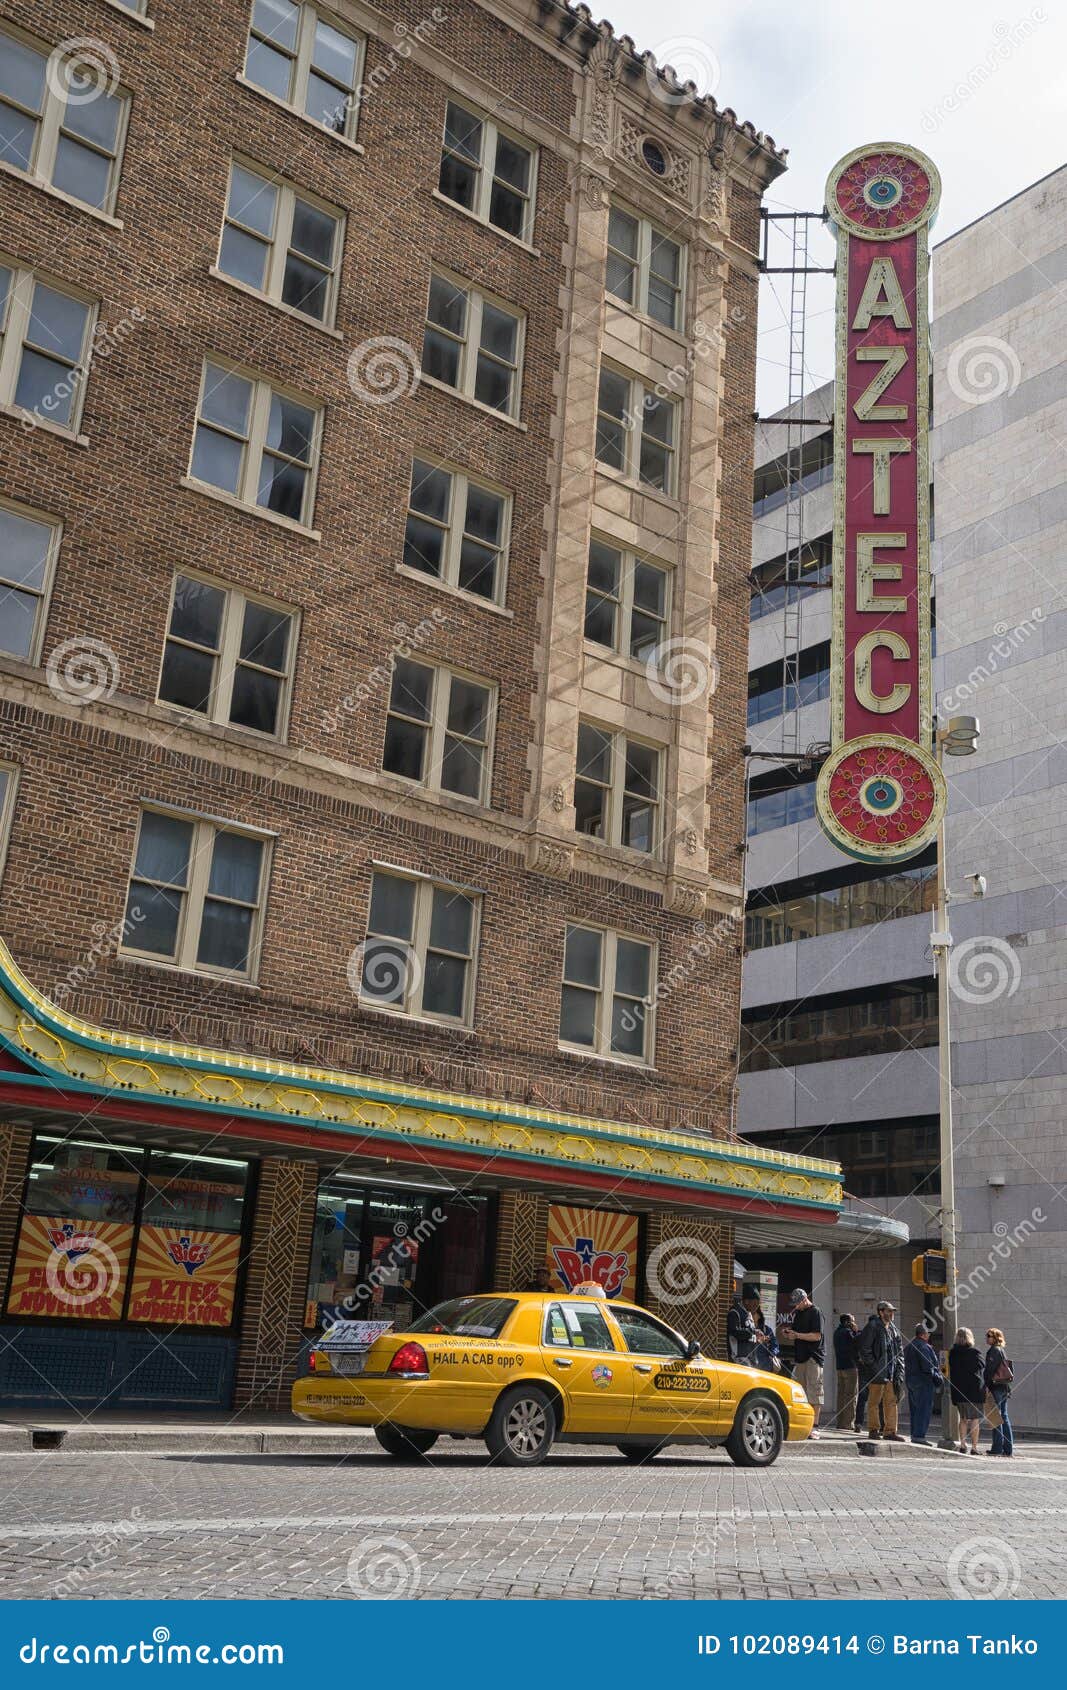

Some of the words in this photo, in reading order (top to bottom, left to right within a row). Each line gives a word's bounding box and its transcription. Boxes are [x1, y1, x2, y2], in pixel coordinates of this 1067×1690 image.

[852, 257, 913, 714] AZTEC
[146, 1279, 220, 1302] AZTEC
[433, 1353, 458, 1364] HAIL
[461, 1354, 470, 1364] A
[472, 1353, 494, 1365] CAB
[497, 1357, 515, 1369] app
[657, 1376, 709, 1391] 210-222-2222
